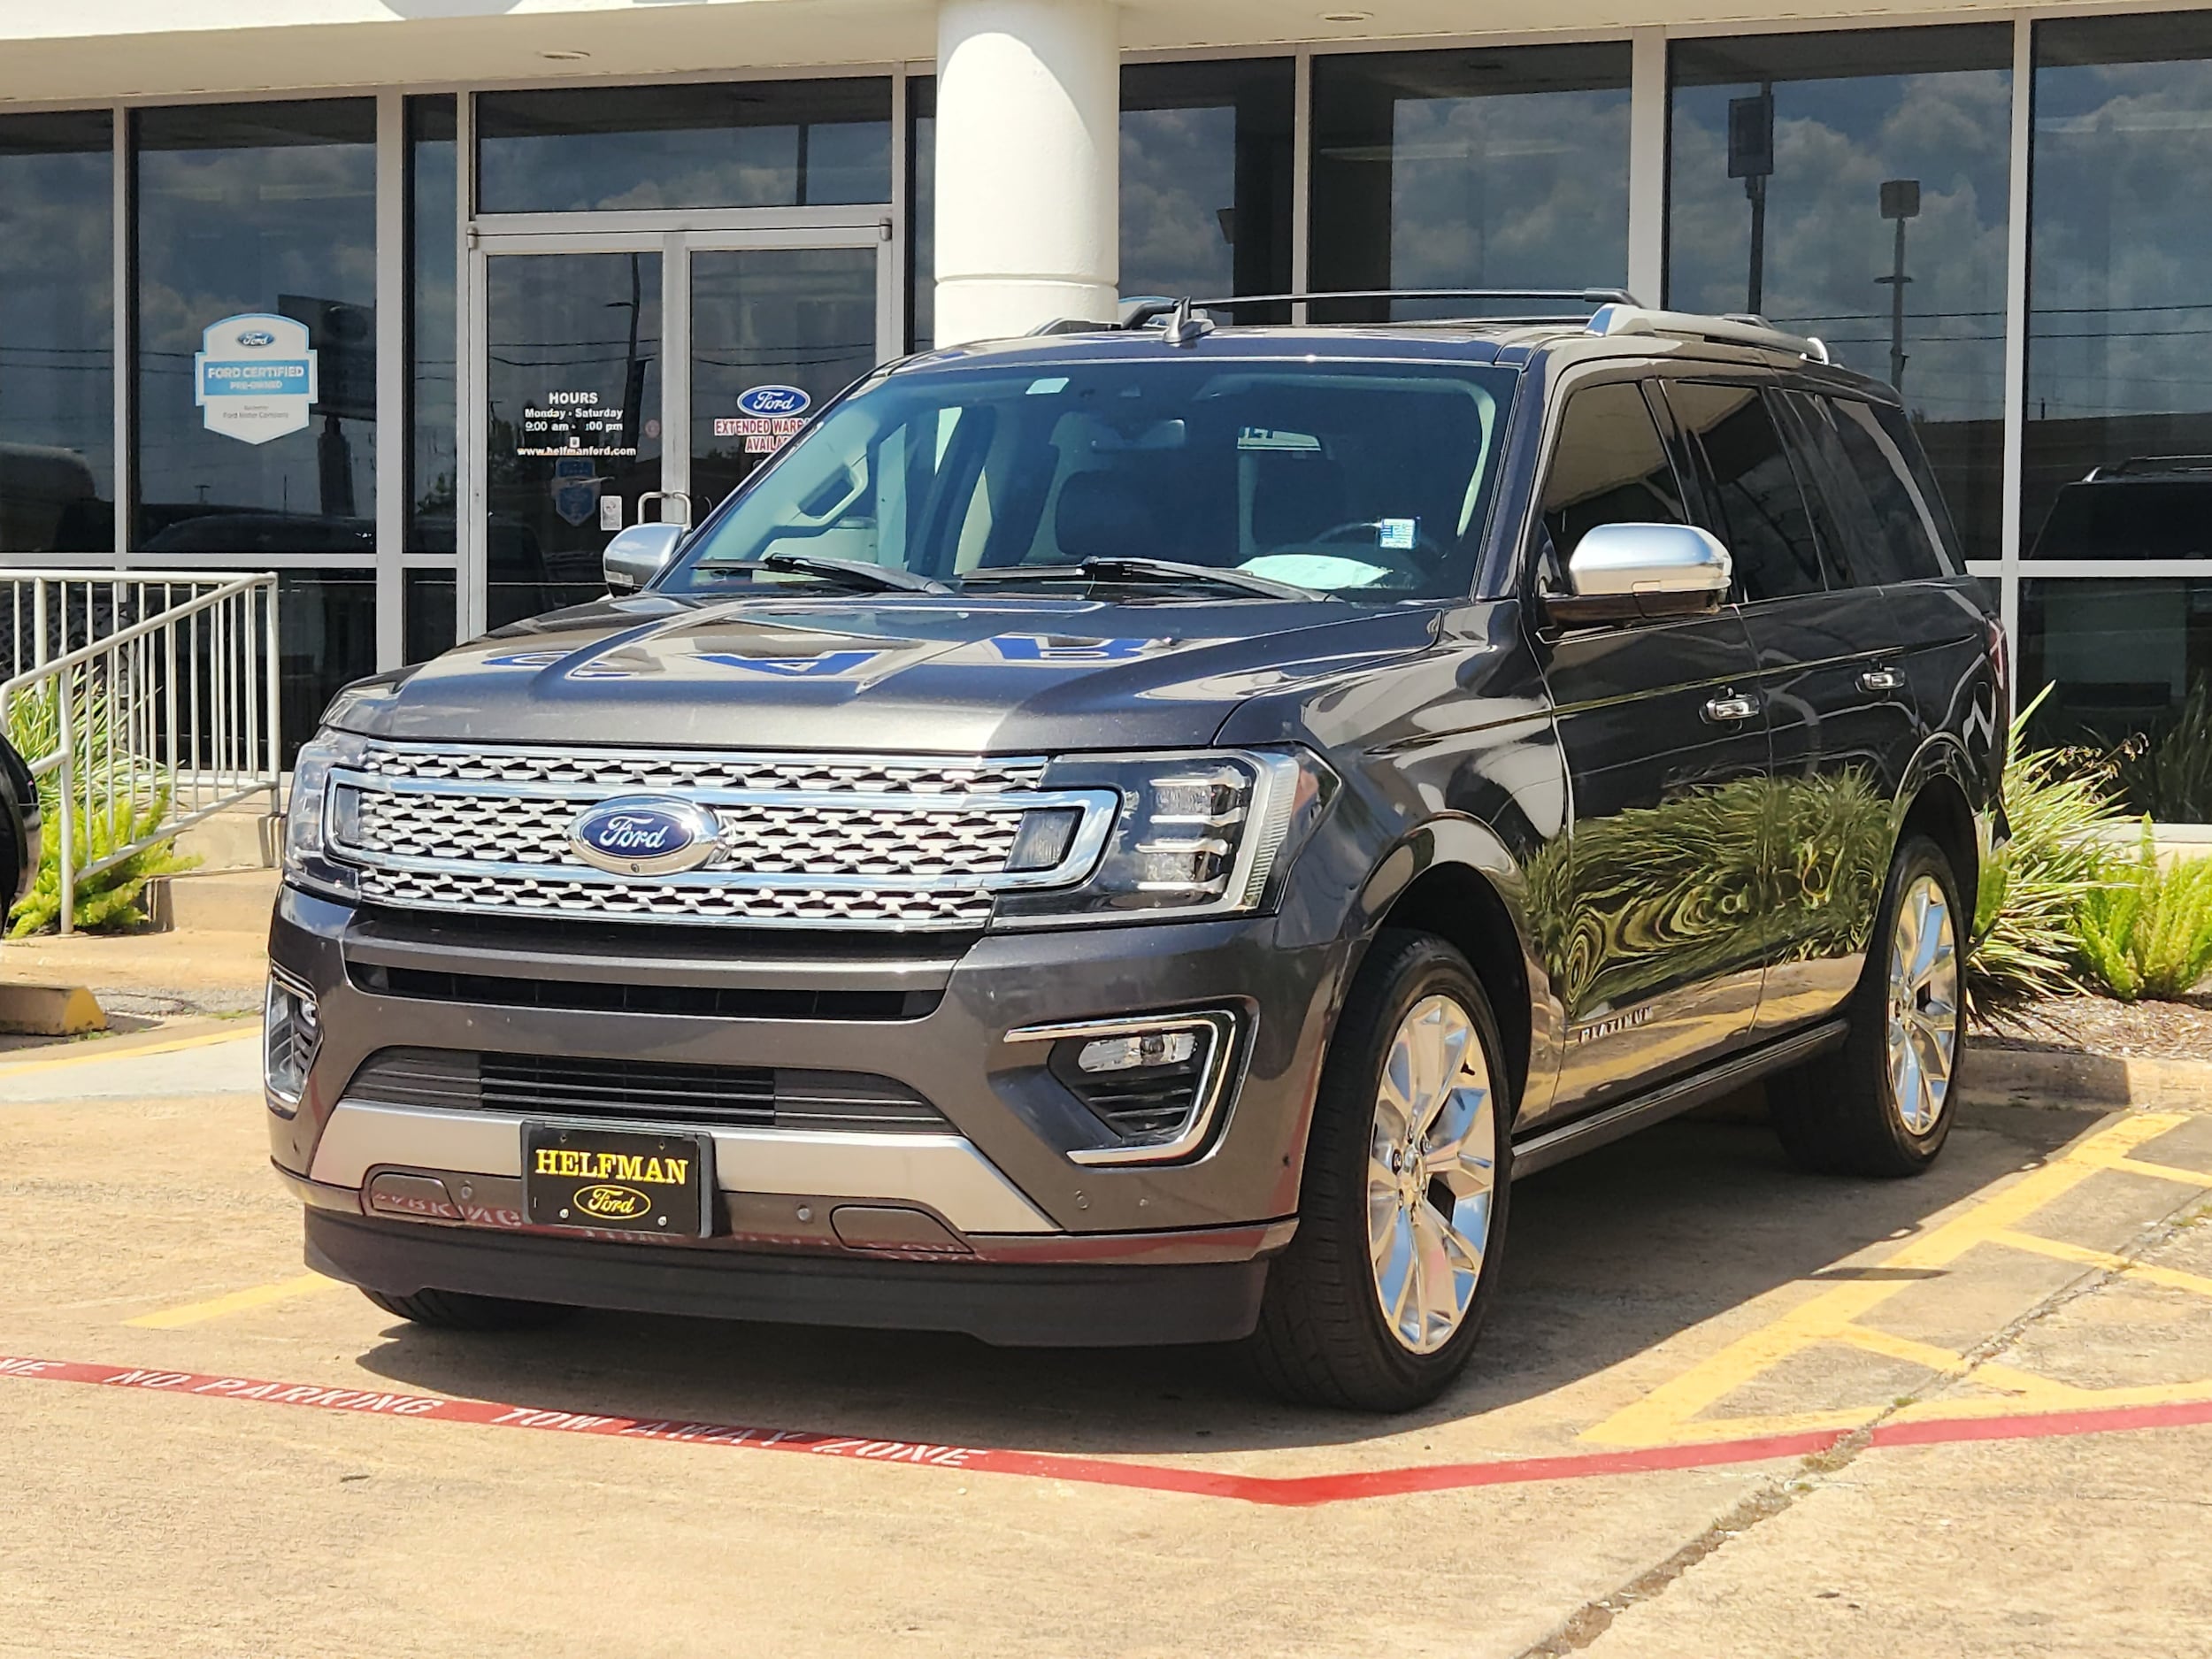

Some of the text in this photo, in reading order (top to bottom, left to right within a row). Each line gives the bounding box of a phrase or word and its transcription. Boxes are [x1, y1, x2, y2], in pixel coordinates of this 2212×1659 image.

[242, 333, 269, 345] Ford
[208, 366, 304, 379] FORD CERTIFIED
[549, 392, 598, 404] HOURS
[753, 390, 795, 410] Ford
[525, 409, 566, 419] Monday
[575, 408, 624, 420] Saturday
[605, 424, 623, 433] pm
[715, 418, 811, 435] EXTENDED WARR
[745, 436, 789, 452] AVAILA
[599, 816, 669, 849] Ford
[534, 1148, 689, 1185] HELFMAN
[588, 1187, 635, 1213] Ford
[102, 1370, 192, 1388] NO
[191, 1377, 444, 1416] PARKING
[490, 1407, 614, 1431] TOW
[621, 1421, 805, 1448] AWAY
[811, 1438, 987, 1467] ZONE
